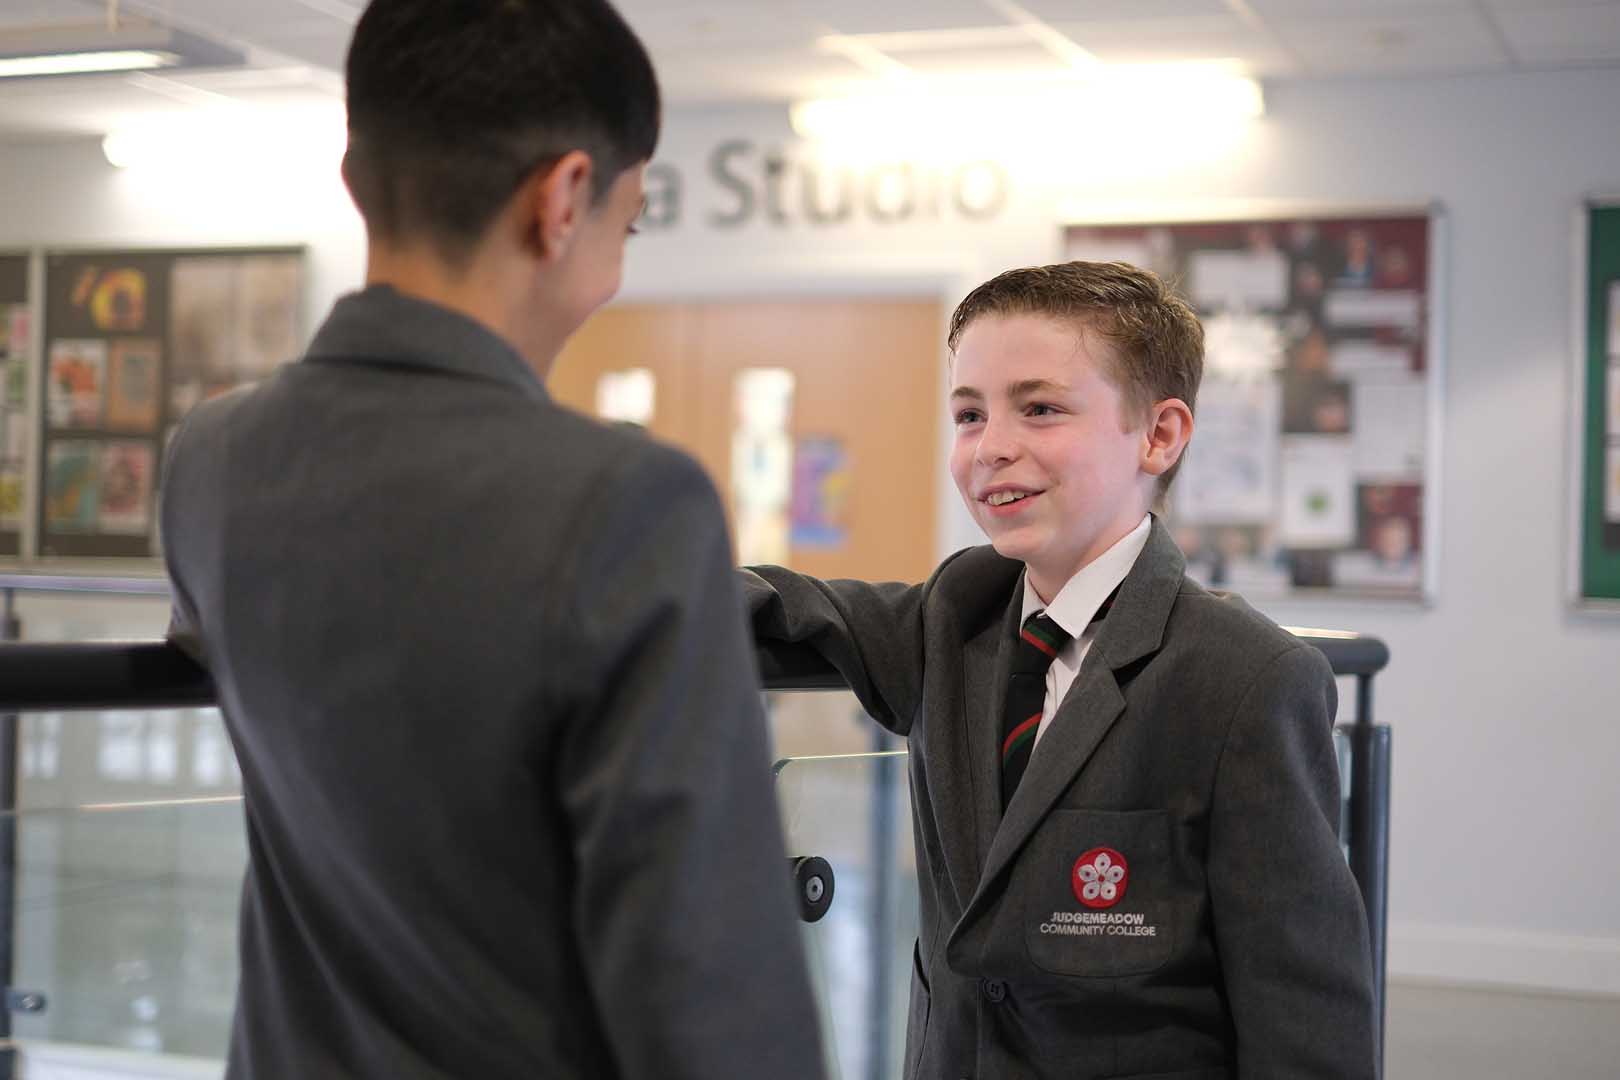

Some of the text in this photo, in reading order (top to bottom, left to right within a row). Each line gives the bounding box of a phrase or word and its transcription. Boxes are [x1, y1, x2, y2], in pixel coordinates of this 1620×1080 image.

[706, 139, 1008, 229] Studio
[1051, 912, 1144, 924] JUDGEMEADOW
[1040, 924, 1156, 936] COMMUNITY COLLEGE
